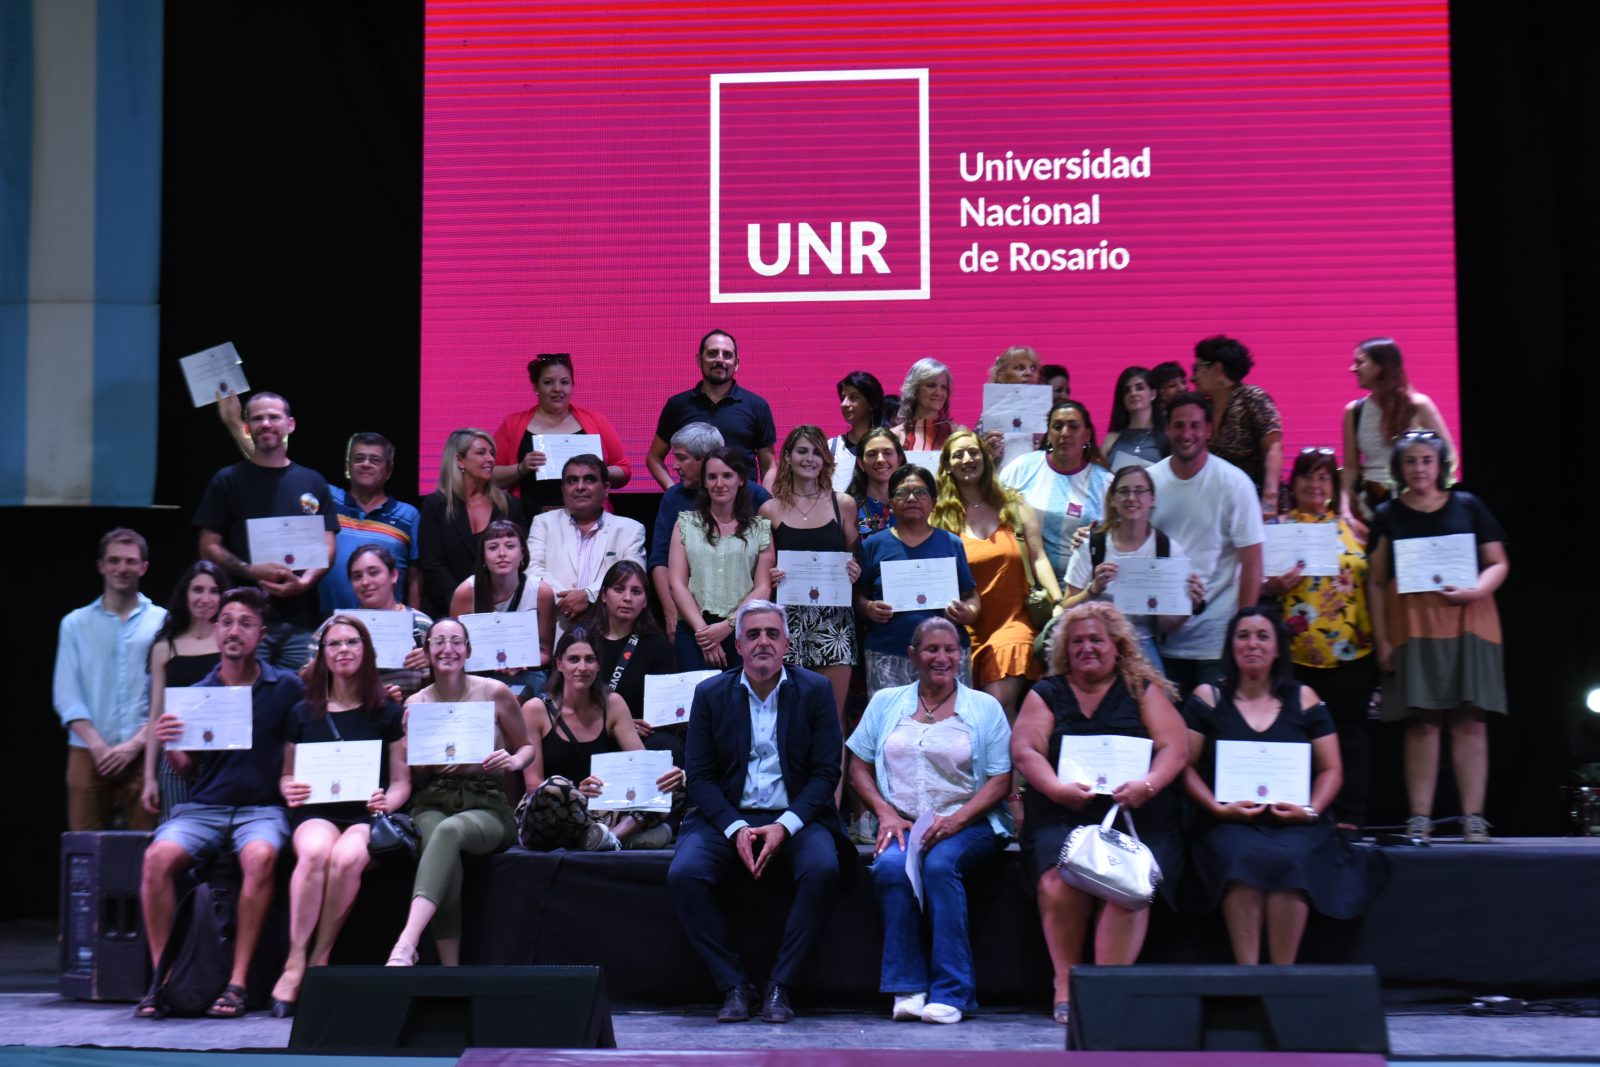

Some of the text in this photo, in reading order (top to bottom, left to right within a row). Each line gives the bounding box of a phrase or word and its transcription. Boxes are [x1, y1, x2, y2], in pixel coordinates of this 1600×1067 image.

[959, 146, 1152, 182] Universidad
[960, 193, 1101, 227] Nacional
[747, 220, 892, 277] UNR
[959, 239, 1131, 273] de Rosario
[609, 666, 624, 690] LOVE
